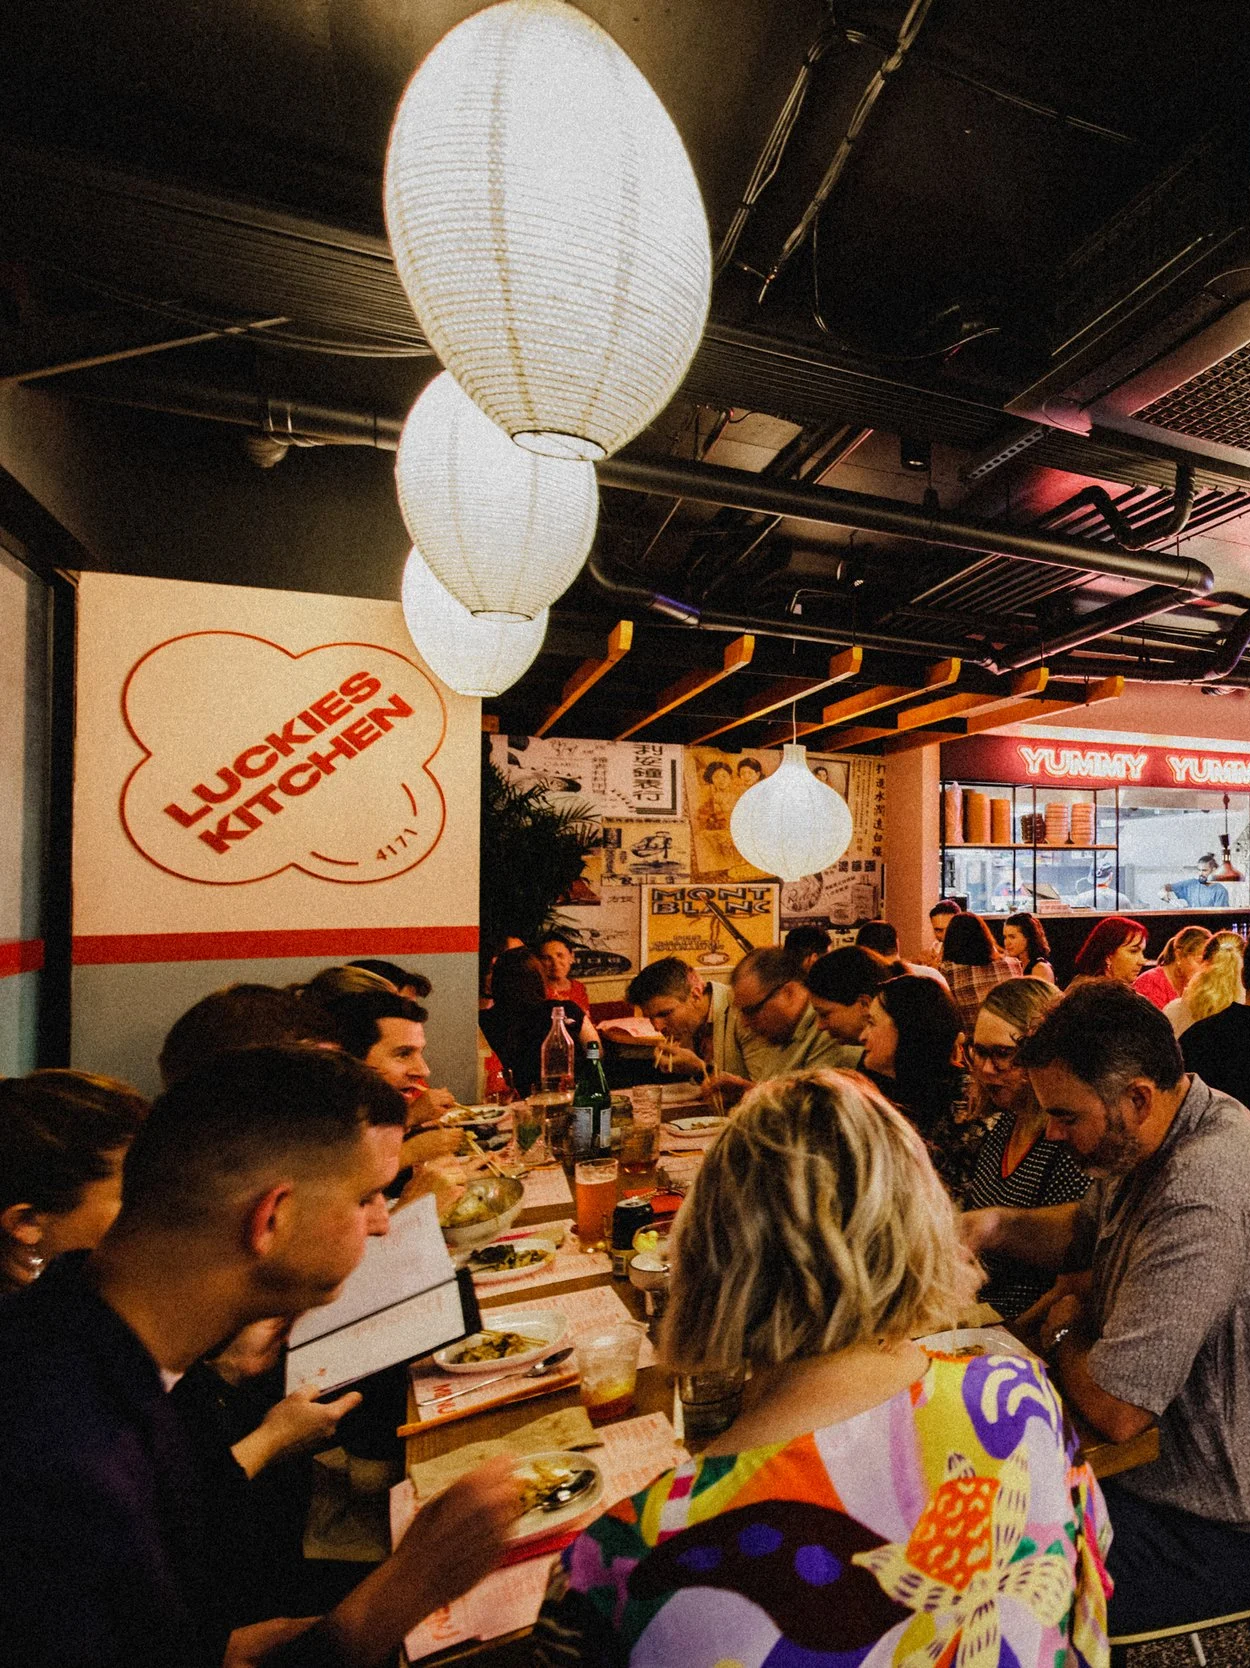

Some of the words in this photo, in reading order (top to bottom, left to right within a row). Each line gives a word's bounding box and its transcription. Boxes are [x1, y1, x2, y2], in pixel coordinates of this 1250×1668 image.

[163, 671, 382, 828] LUCKIES
[1018, 745, 1148, 780] YUMMY
[198, 693, 415, 855] KITCHEN
[376, 828, 417, 861] 4171
[651, 887, 771, 901] MONT
